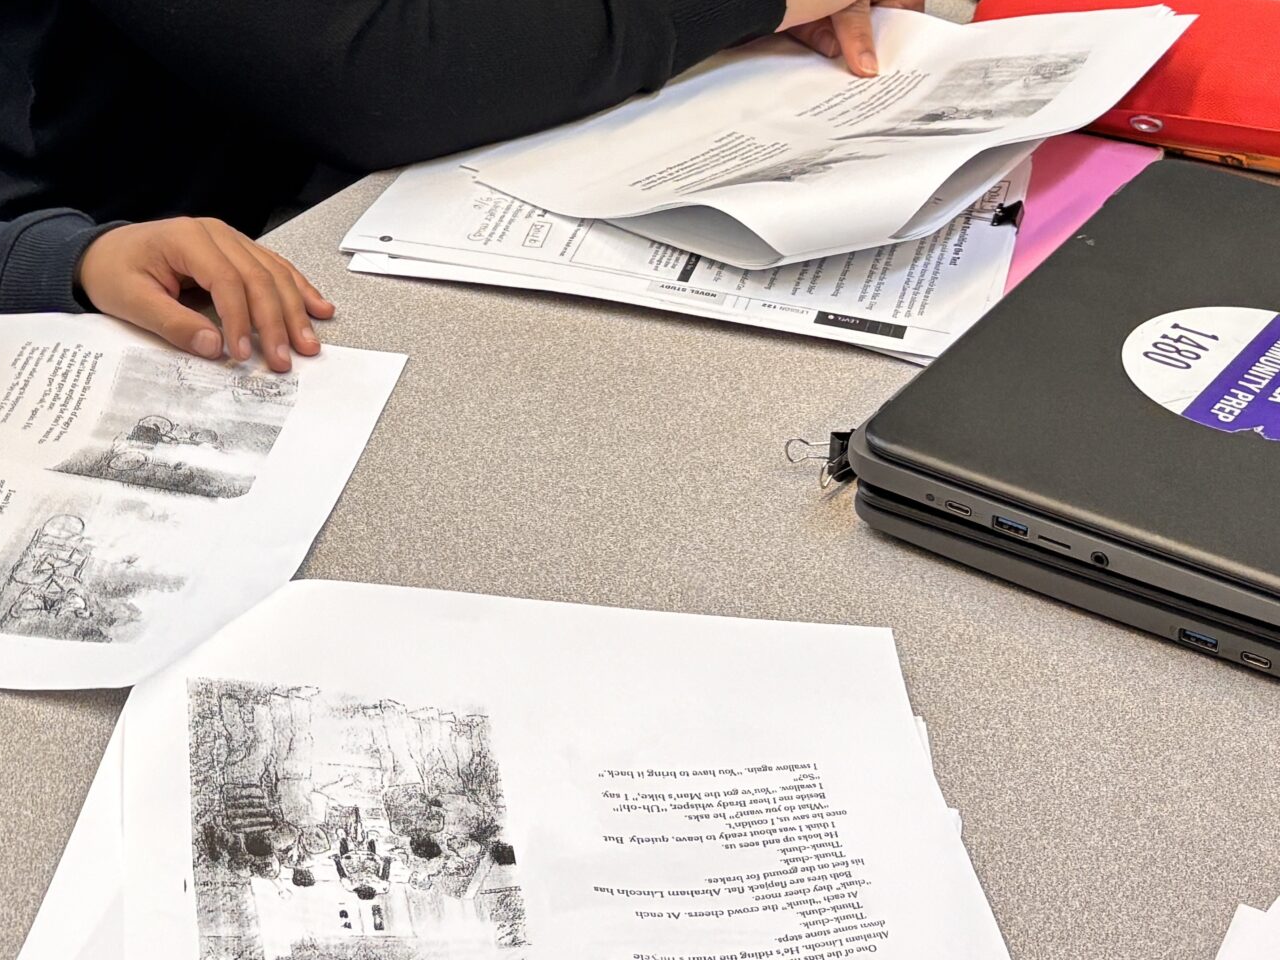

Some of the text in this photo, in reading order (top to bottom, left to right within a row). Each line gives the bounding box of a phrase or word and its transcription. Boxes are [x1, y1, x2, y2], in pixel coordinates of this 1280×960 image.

[659, 283, 717, 298] NOVEL STUDY
[761, 302, 778, 310] 122
[1143, 323, 1219, 369] 1480
[1210, 388, 1255, 423] PREP
[743, 764, 773, 774] again.
[774, 762, 811, 772] swallow
[812, 762, 818, 771] I
[636, 770, 645, 779] it
[645, 768, 677, 779] bring
[691, 769, 716, 778] have
[778, 782, 817, 792] swallow.
[817, 781, 824, 790] I
[600, 789, 621, 799] say.
[623, 792, 629, 801] I
[703, 790, 721, 799] the
[722, 788, 739, 797] got
[794, 791, 826, 801] Beside
[715, 799, 747, 810] Brady
[748, 797, 771, 805] hear
[771, 796, 777, 804] I
[668, 800, 714, 811] whisper,
[764, 803, 782, 813] you
[782, 804, 796, 813] do
[683, 813, 710, 822] asks.
[712, 811, 727, 820] he
[791, 813, 810, 821] saw
[810, 811, 824, 819] he
[825, 809, 847, 817] once
[769, 817, 775, 826] I
[804, 821, 829, 831] think
[830, 820, 836, 828] I
[748, 827, 777, 837] about
[777, 825, 797, 833] was
[797, 824, 803, 832] I
[601, 834, 624, 844] But
[670, 834, 704, 843] leave,
[704, 833, 717, 841] to
[718, 830, 748, 841] ready
[720, 830, 839, 850] He looks up and sees us.
[776, 840, 843, 856] Thunk-clunk.
[778, 850, 846, 866] Thunk-clunk.
[703, 857, 865, 885] his feet on the ground for brakes.
[592, 869, 853, 898] Both tires are flapjack flat. Abraham Lincoln has
[812, 883, 833, 892] they
[751, 891, 782, 901] more.
[783, 887, 811, 897] cheer
[846, 889, 858, 899] At
[822, 892, 846, 903] each
[726, 905, 760, 917] crowd
[761, 903, 779, 912] the
[795, 900, 864, 918] Thunk-clunk.
[634, 910, 664, 919] each
[665, 911, 681, 920] At
[683, 909, 724, 918] cheers.
[798, 911, 867, 929] Thunk-clunk.
[773, 919, 886, 943] down some stone steps.
[844, 929, 889, 943] Abraham
[801, 937, 844, 952] Lincoln.
[855, 943, 877, 953] One
[738, 949, 774, 959] riding
[826, 949, 843, 958] the
[843, 947, 854, 957] of
